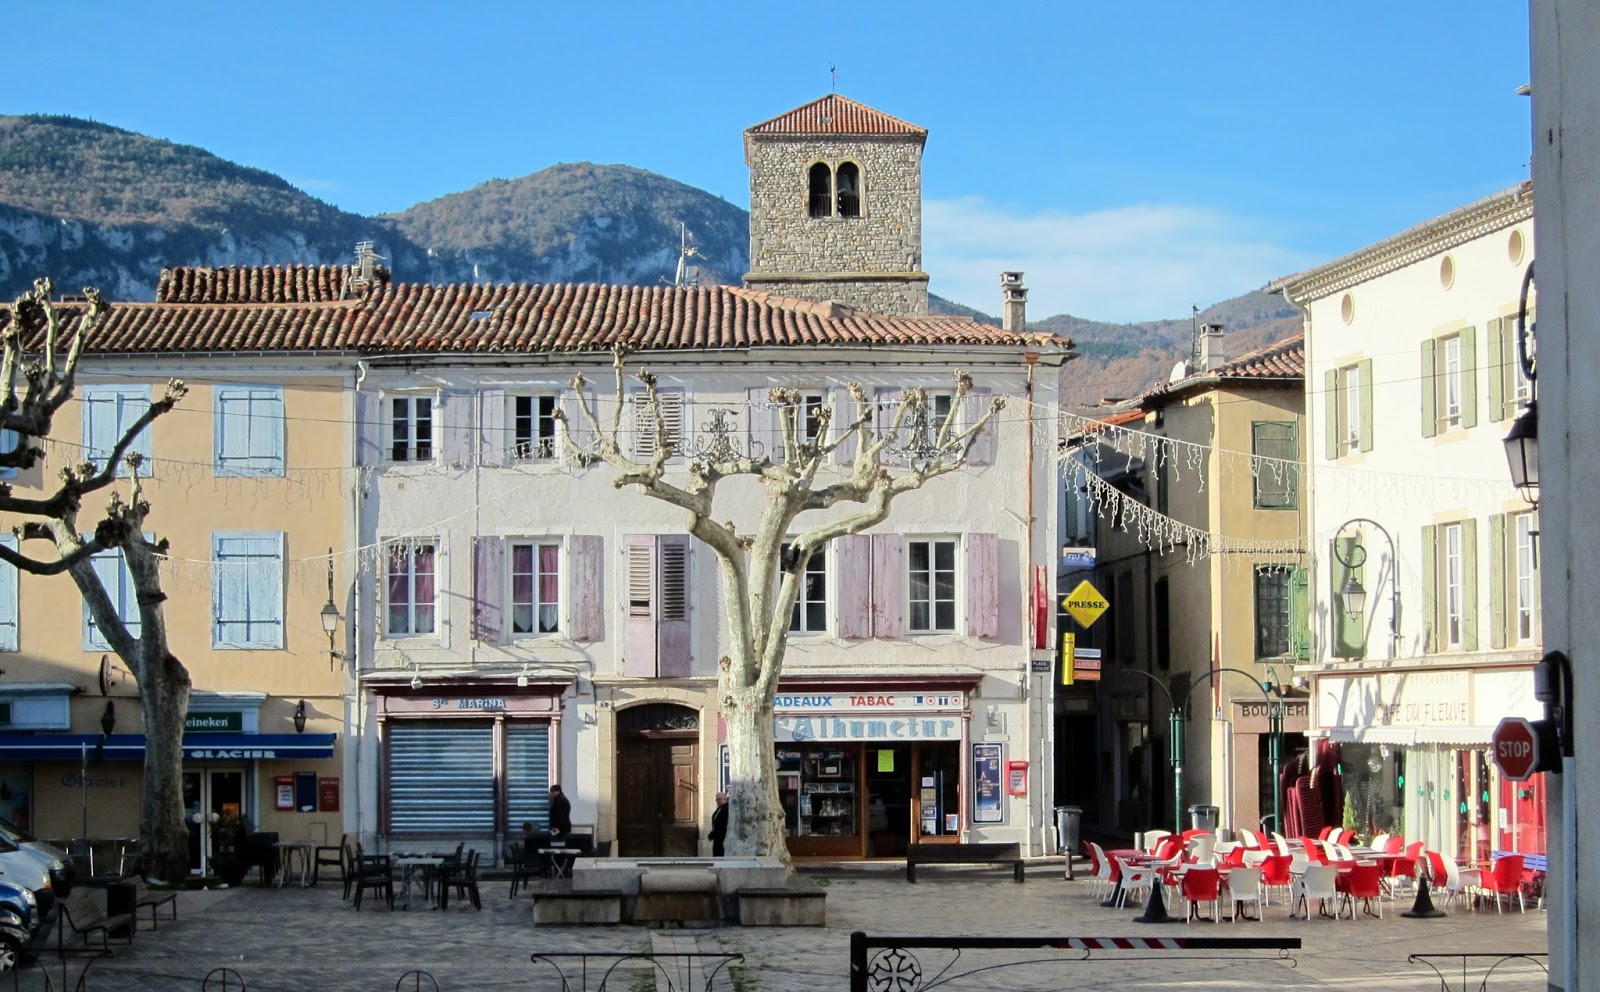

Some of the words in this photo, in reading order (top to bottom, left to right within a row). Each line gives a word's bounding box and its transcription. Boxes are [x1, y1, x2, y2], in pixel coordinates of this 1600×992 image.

[774, 695, 832, 707] ADEAUX
[850, 695, 895, 707] TABAC
[913, 695, 960, 706] LOTO
[1406, 702, 1420, 722] DU
[1424, 701, 1467, 723] FLEUVE
[185, 717, 228, 728] eineken
[191, 750, 276, 759] GLACIER
[1499, 741, 1530, 758] STOP
